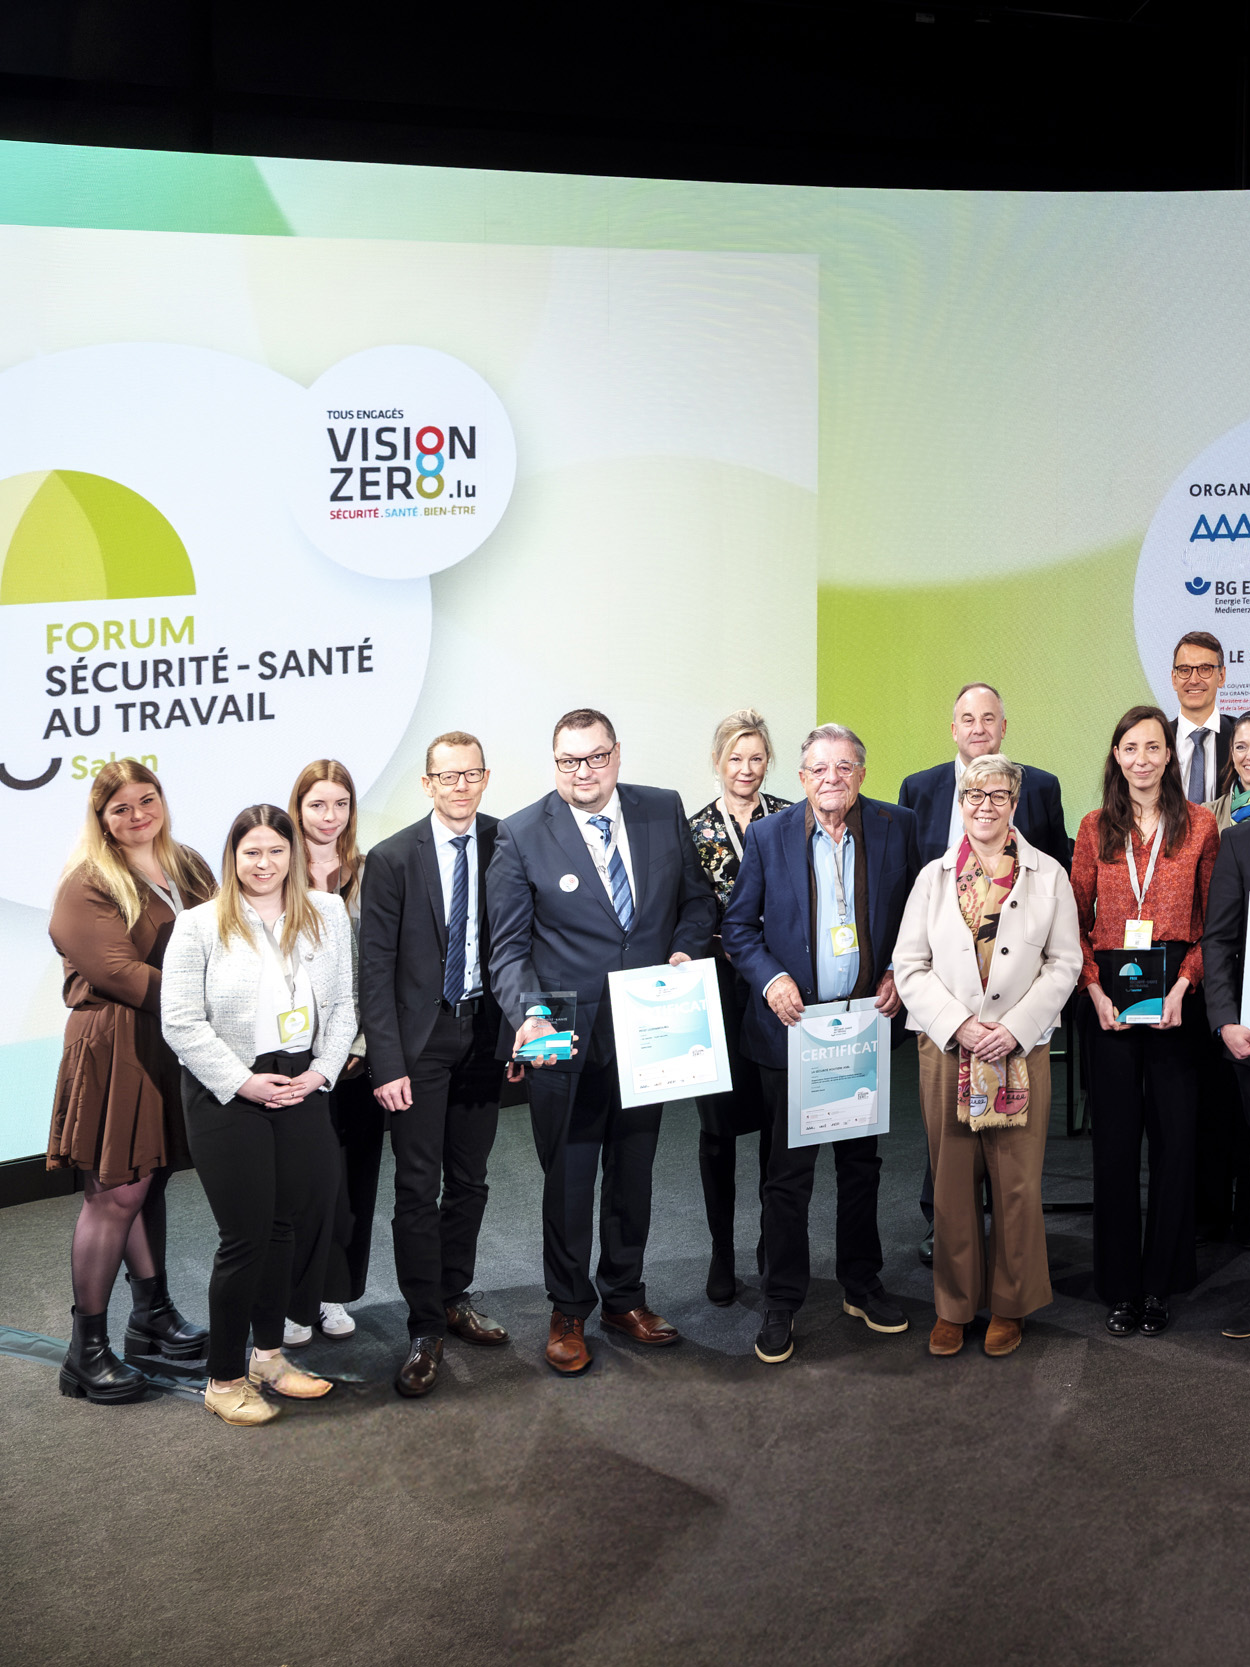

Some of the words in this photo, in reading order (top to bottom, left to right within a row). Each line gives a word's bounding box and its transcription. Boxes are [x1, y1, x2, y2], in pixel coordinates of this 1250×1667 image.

[327, 410, 354, 419] TOUS
[357, 408, 404, 419] ENGAGÉS
[326, 425, 476, 462] VISION
[424, 504, 476, 517] BIEN-ÊTRE
[1215, 580, 1237, 596] BG
[1215, 597, 1241, 607] Energie
[45, 615, 196, 655] FORUM
[1229, 650, 1246, 664] LE
[43, 706, 101, 740] AU
[115, 692, 276, 735] TRAVAIL
[71, 751, 159, 780] San
[801, 1039, 878, 1063] CERTIFICAT
